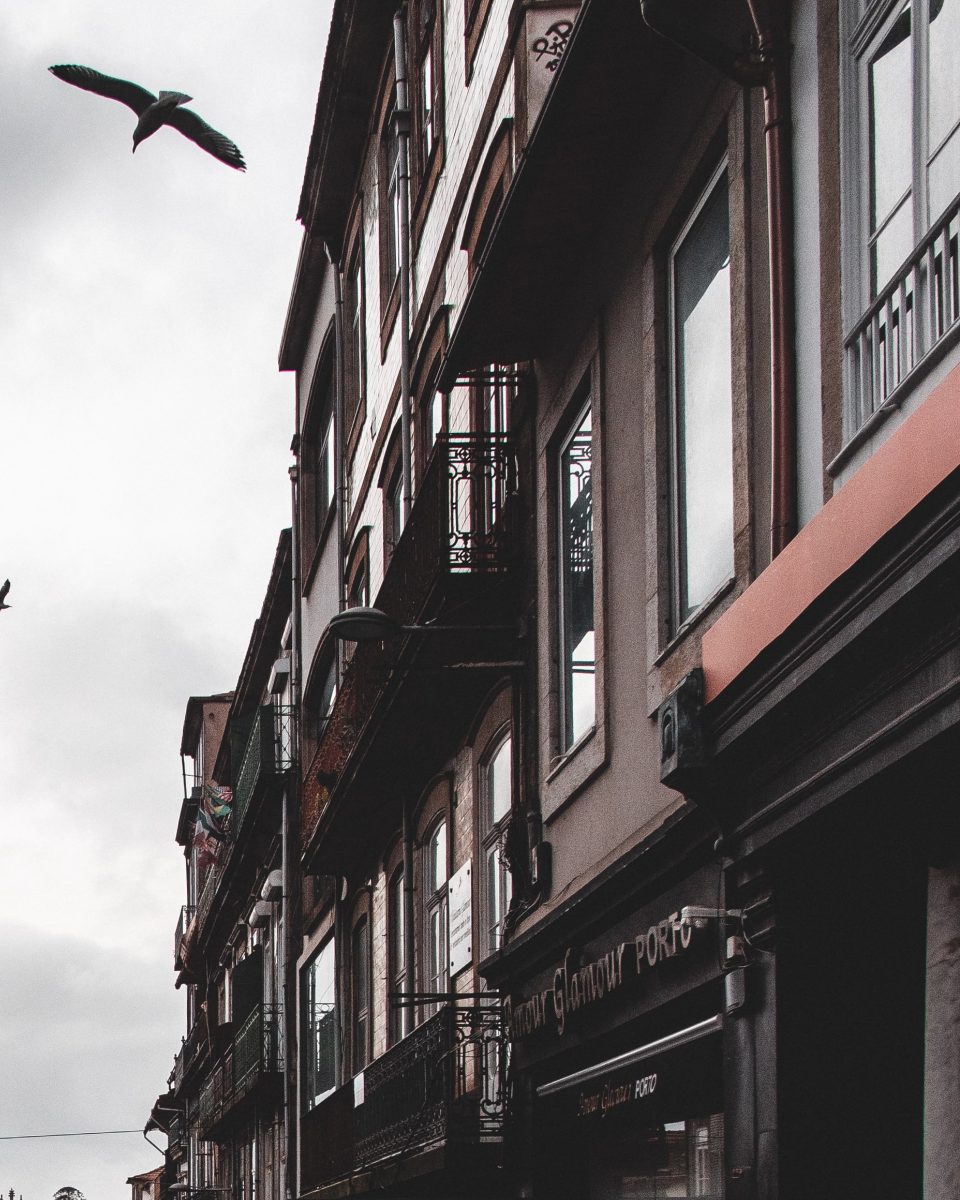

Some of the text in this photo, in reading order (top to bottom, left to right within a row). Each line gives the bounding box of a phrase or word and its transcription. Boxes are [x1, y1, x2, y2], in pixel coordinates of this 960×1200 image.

[552, 946, 627, 1037] Glamour
[635, 910, 692, 976] PORTO
[634, 1073, 658, 1100] PORTO
